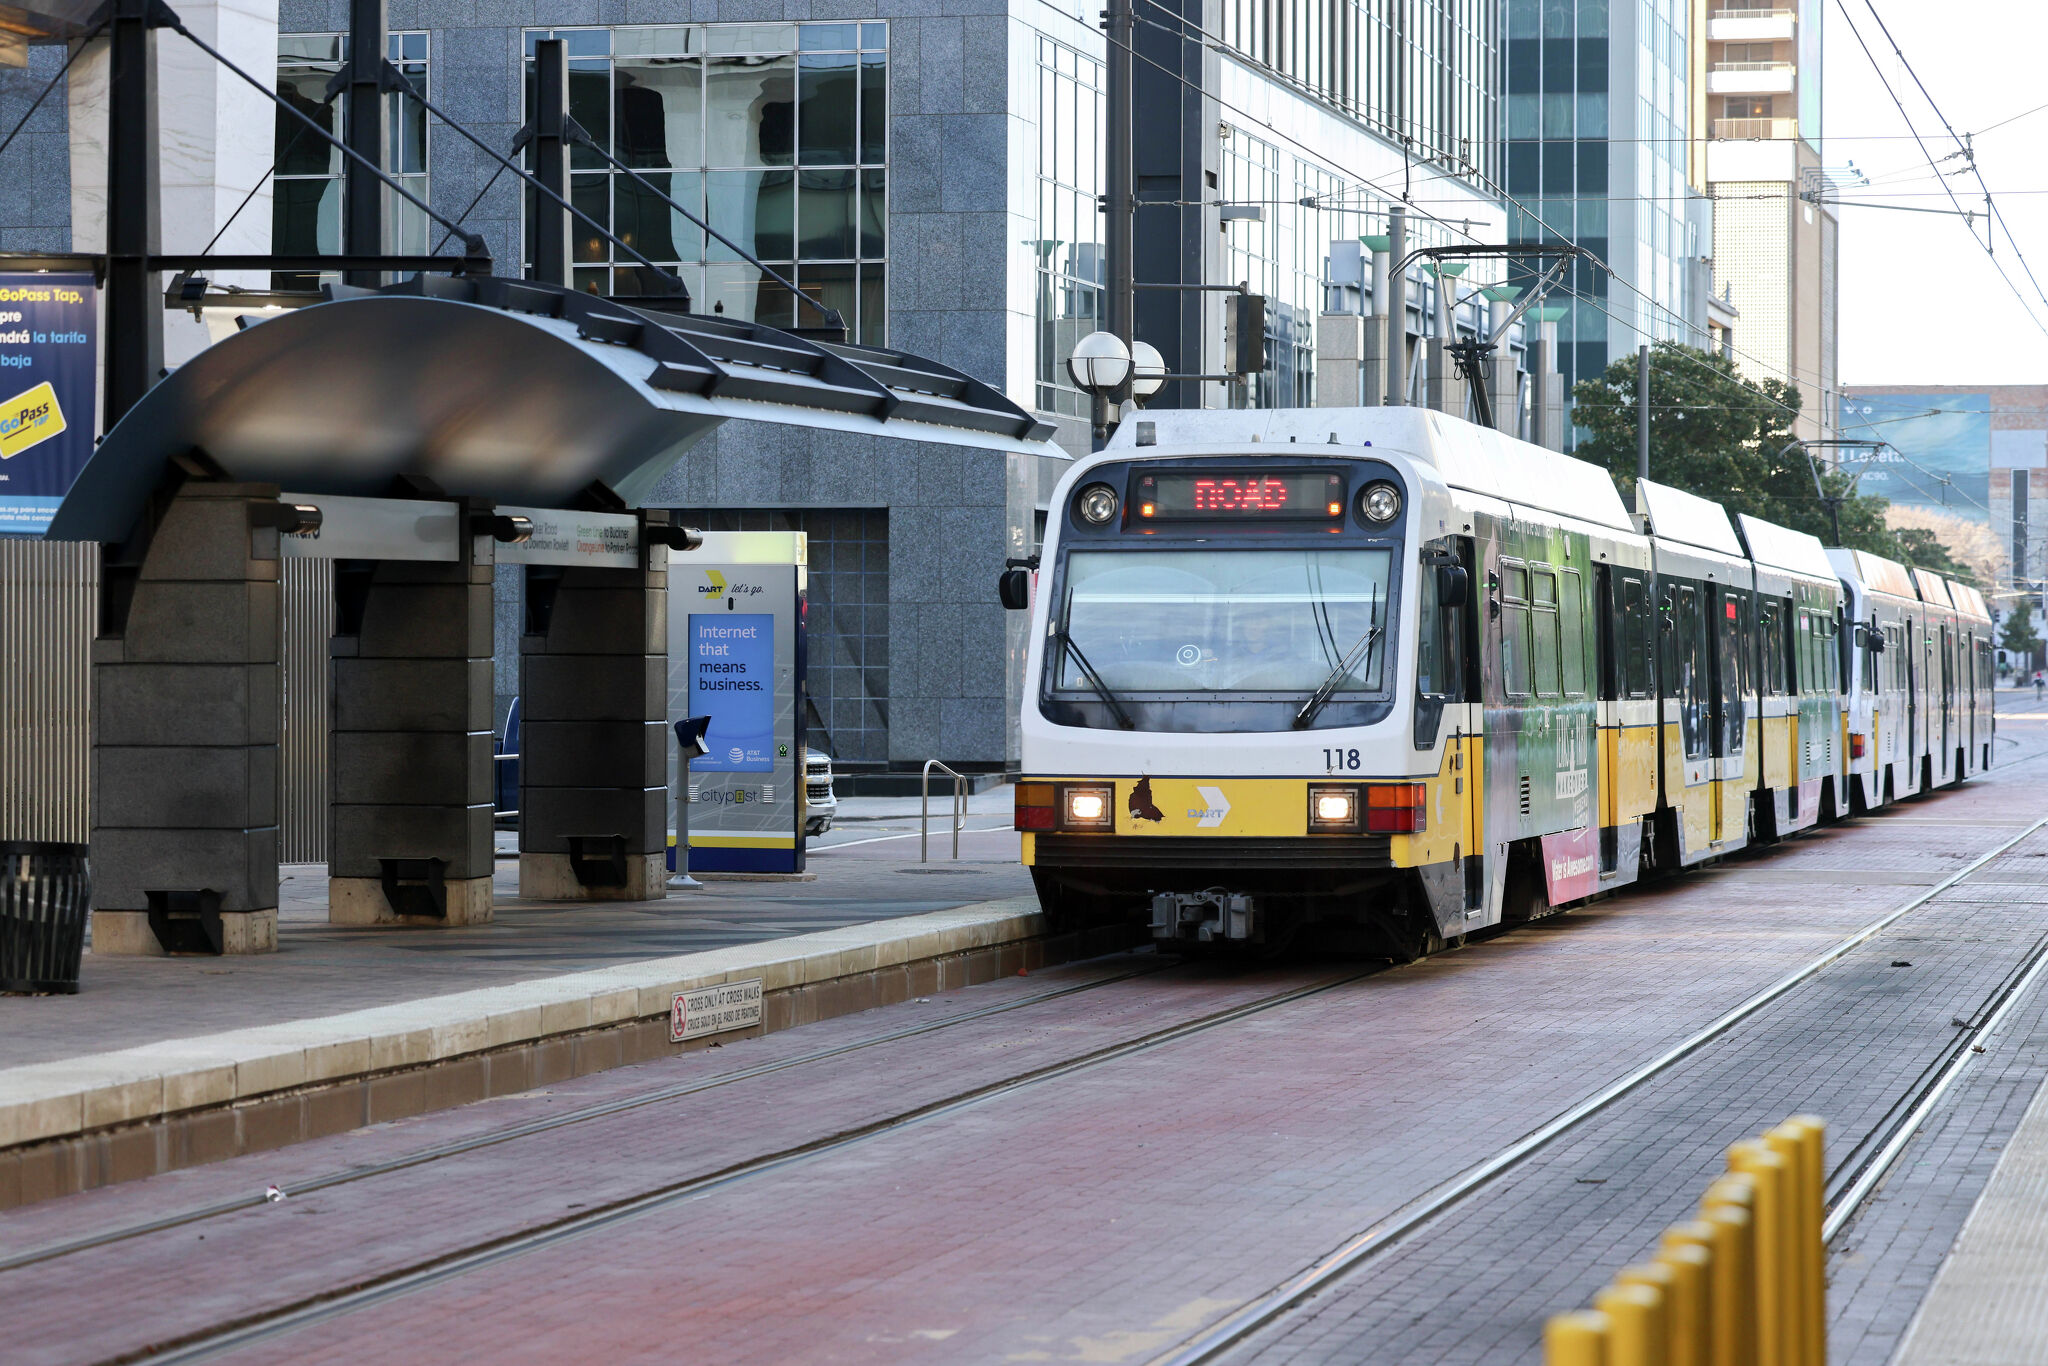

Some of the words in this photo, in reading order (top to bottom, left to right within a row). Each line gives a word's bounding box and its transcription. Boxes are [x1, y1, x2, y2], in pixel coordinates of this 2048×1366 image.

[0, 288, 51, 302] GoPass
[53, 288, 84, 304] Tap,
[33, 331, 47, 344] la
[50, 331, 87, 344] tarifa
[0, 354, 33, 369] baja
[0, 402, 49, 434] GoPass
[1195, 480, 1287, 509] ROAD
[731, 584, 749, 593] let's
[751, 587, 764, 596] go.
[699, 625, 757, 639] Internet
[699, 642, 729, 656] that
[699, 663, 746, 673] means
[699, 677, 764, 691] business.
[1322, 748, 1361, 770] 118
[1187, 808, 1224, 818] DART
[687, 996, 704, 1012] CROSS
[705, 993, 718, 1009] ONLY
[718, 992, 726, 1006] AT
[726, 988, 743, 1004] CROSS
[743, 986, 760, 1000] WALKS
[687, 1017, 700, 1031] CRUCE
[700, 1015, 711, 1028] SOLO
[711, 1014, 717, 1025] EN
[717, 1012, 723, 1025] EL
[723, 1010, 734, 1023] PASO
[735, 1008, 741, 1021] DE
[741, 1005, 760, 1020] PEATONES
